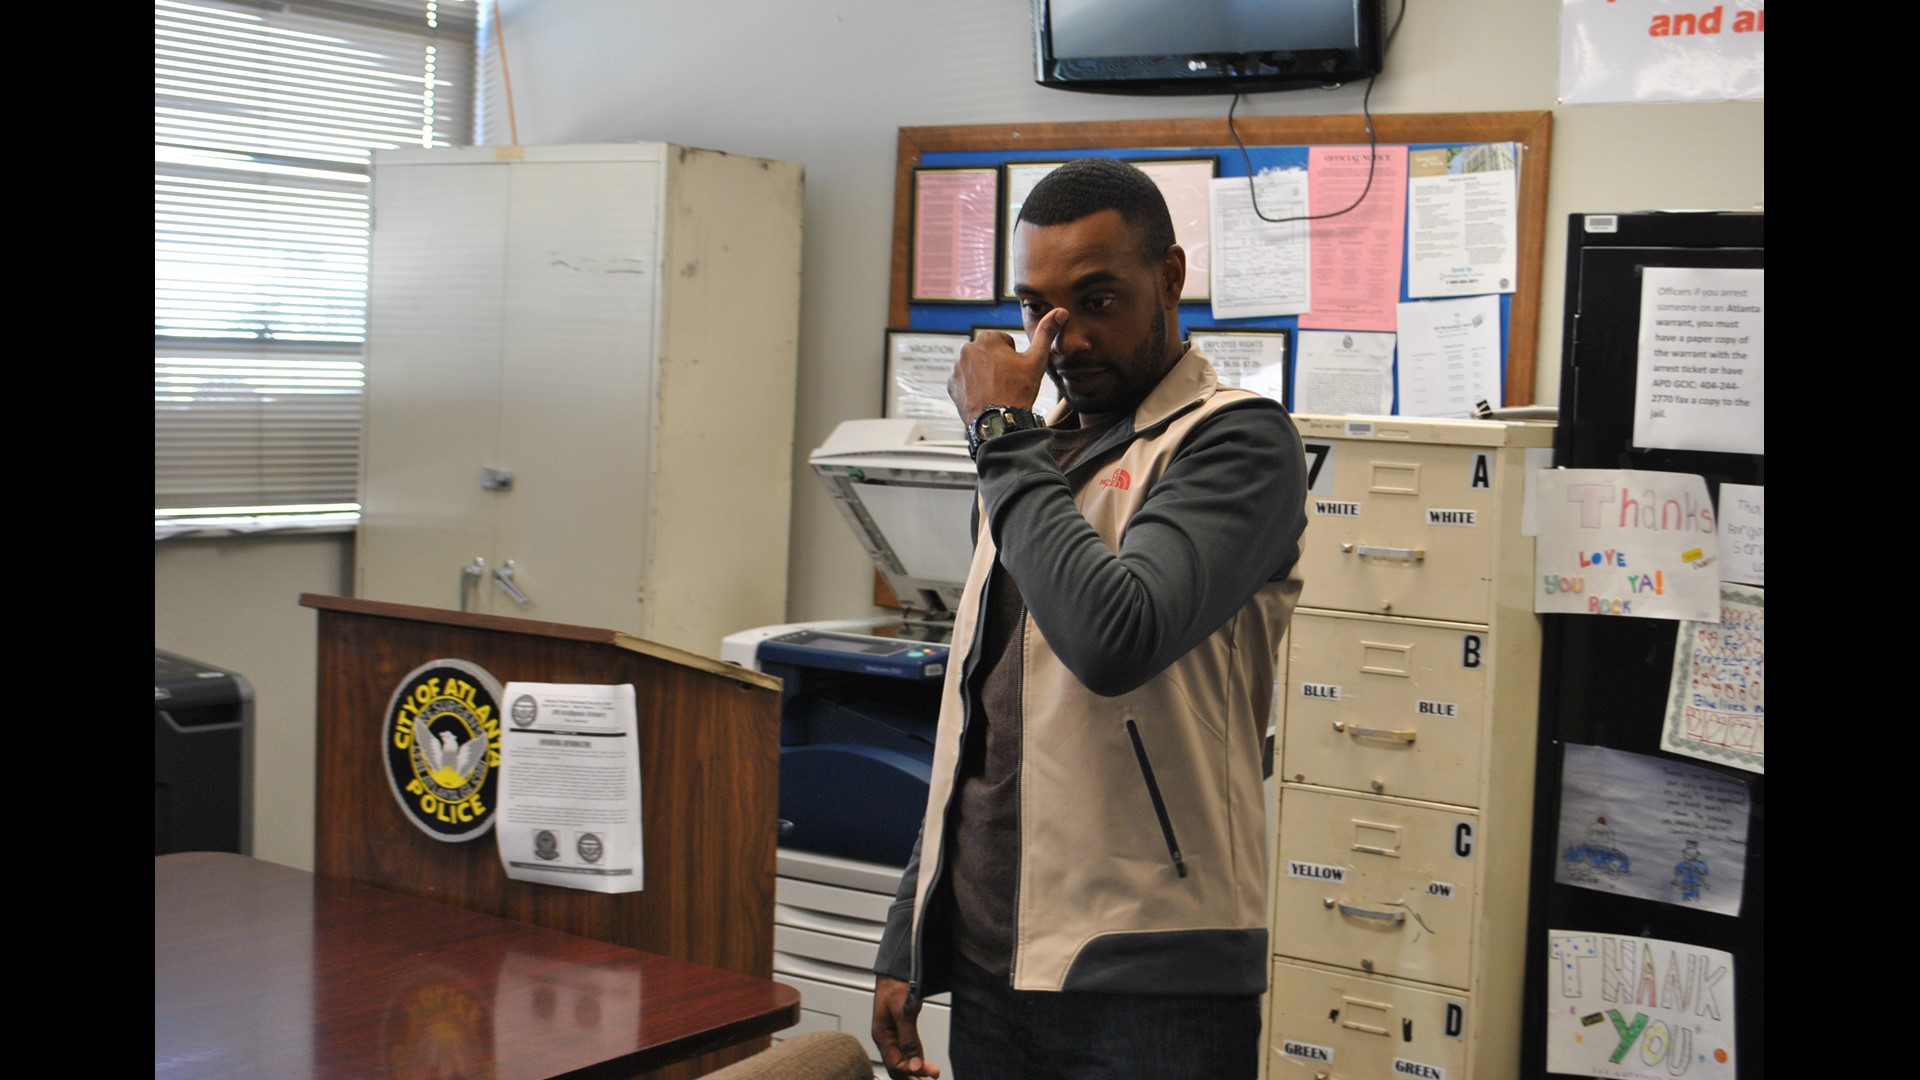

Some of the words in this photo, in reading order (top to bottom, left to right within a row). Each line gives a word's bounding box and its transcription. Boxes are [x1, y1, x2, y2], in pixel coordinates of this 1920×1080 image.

[1648, 6, 1724, 37] and
[1658, 287, 1692, 296] Officers
[1693, 287, 1700, 296] if
[1701, 290, 1719, 298] you
[1721, 289, 1748, 298] arrest
[1656, 304, 1697, 312] someone
[1726, 304, 1761, 313] Atlanta
[1656, 319, 1694, 328] warrant,
[1696, 321, 1714, 329] you
[1715, 321, 1739, 329] must
[1655, 333, 1677, 342] have
[1686, 336, 1713, 344] paper
[1714, 336, 1736, 345] copy
[1738, 335, 1749, 344] of
[909, 344, 955, 354] VACATION
[1654, 348, 1669, 358] the
[1671, 350, 1708, 358] warrant
[1709, 350, 1730, 359] with
[1731, 350, 1748, 360] the
[1652, 365, 1679, 373] arrest
[1681, 365, 1708, 374] ticket
[1721, 366, 1744, 375] have
[1652, 379, 1672, 388] APD
[1699, 380, 1741, 390] 404-244-
[1652, 394, 1674, 403] 2770
[1675, 395, 1689, 404] fax
[1698, 398, 1720, 407] copy
[1722, 397, 1733, 406] to
[1734, 398, 1751, 407] the
[1650, 408, 1668, 420] jail.
[1471, 454, 1490, 489] A
[1315, 500, 1360, 516] WHITE
[1428, 510, 1476, 525] WHITE
[1567, 484, 1715, 534] Thanks
[1578, 549, 1627, 568] LOVE
[1627, 570, 1664, 596] YA!
[1588, 596, 1632, 615] ROCK
[1462, 634, 1482, 669] B
[415, 677, 440, 704] OF
[1303, 684, 1339, 699] BLUE
[1418, 701, 1456, 717] BLUE
[393, 695, 419, 750] CITY
[443, 677, 501, 768] ATLANTA
[405, 779, 487, 824] POLICE
[1454, 823, 1472, 858] C
[1291, 863, 1345, 882] YELLOW
[1550, 936, 1727, 1021] THANK
[1445, 1003, 1463, 1037] D
[1284, 1041, 1328, 1061] GREEN
[1604, 1008, 1693, 1077] YOU
[1395, 1059, 1441, 1080] GREEN
